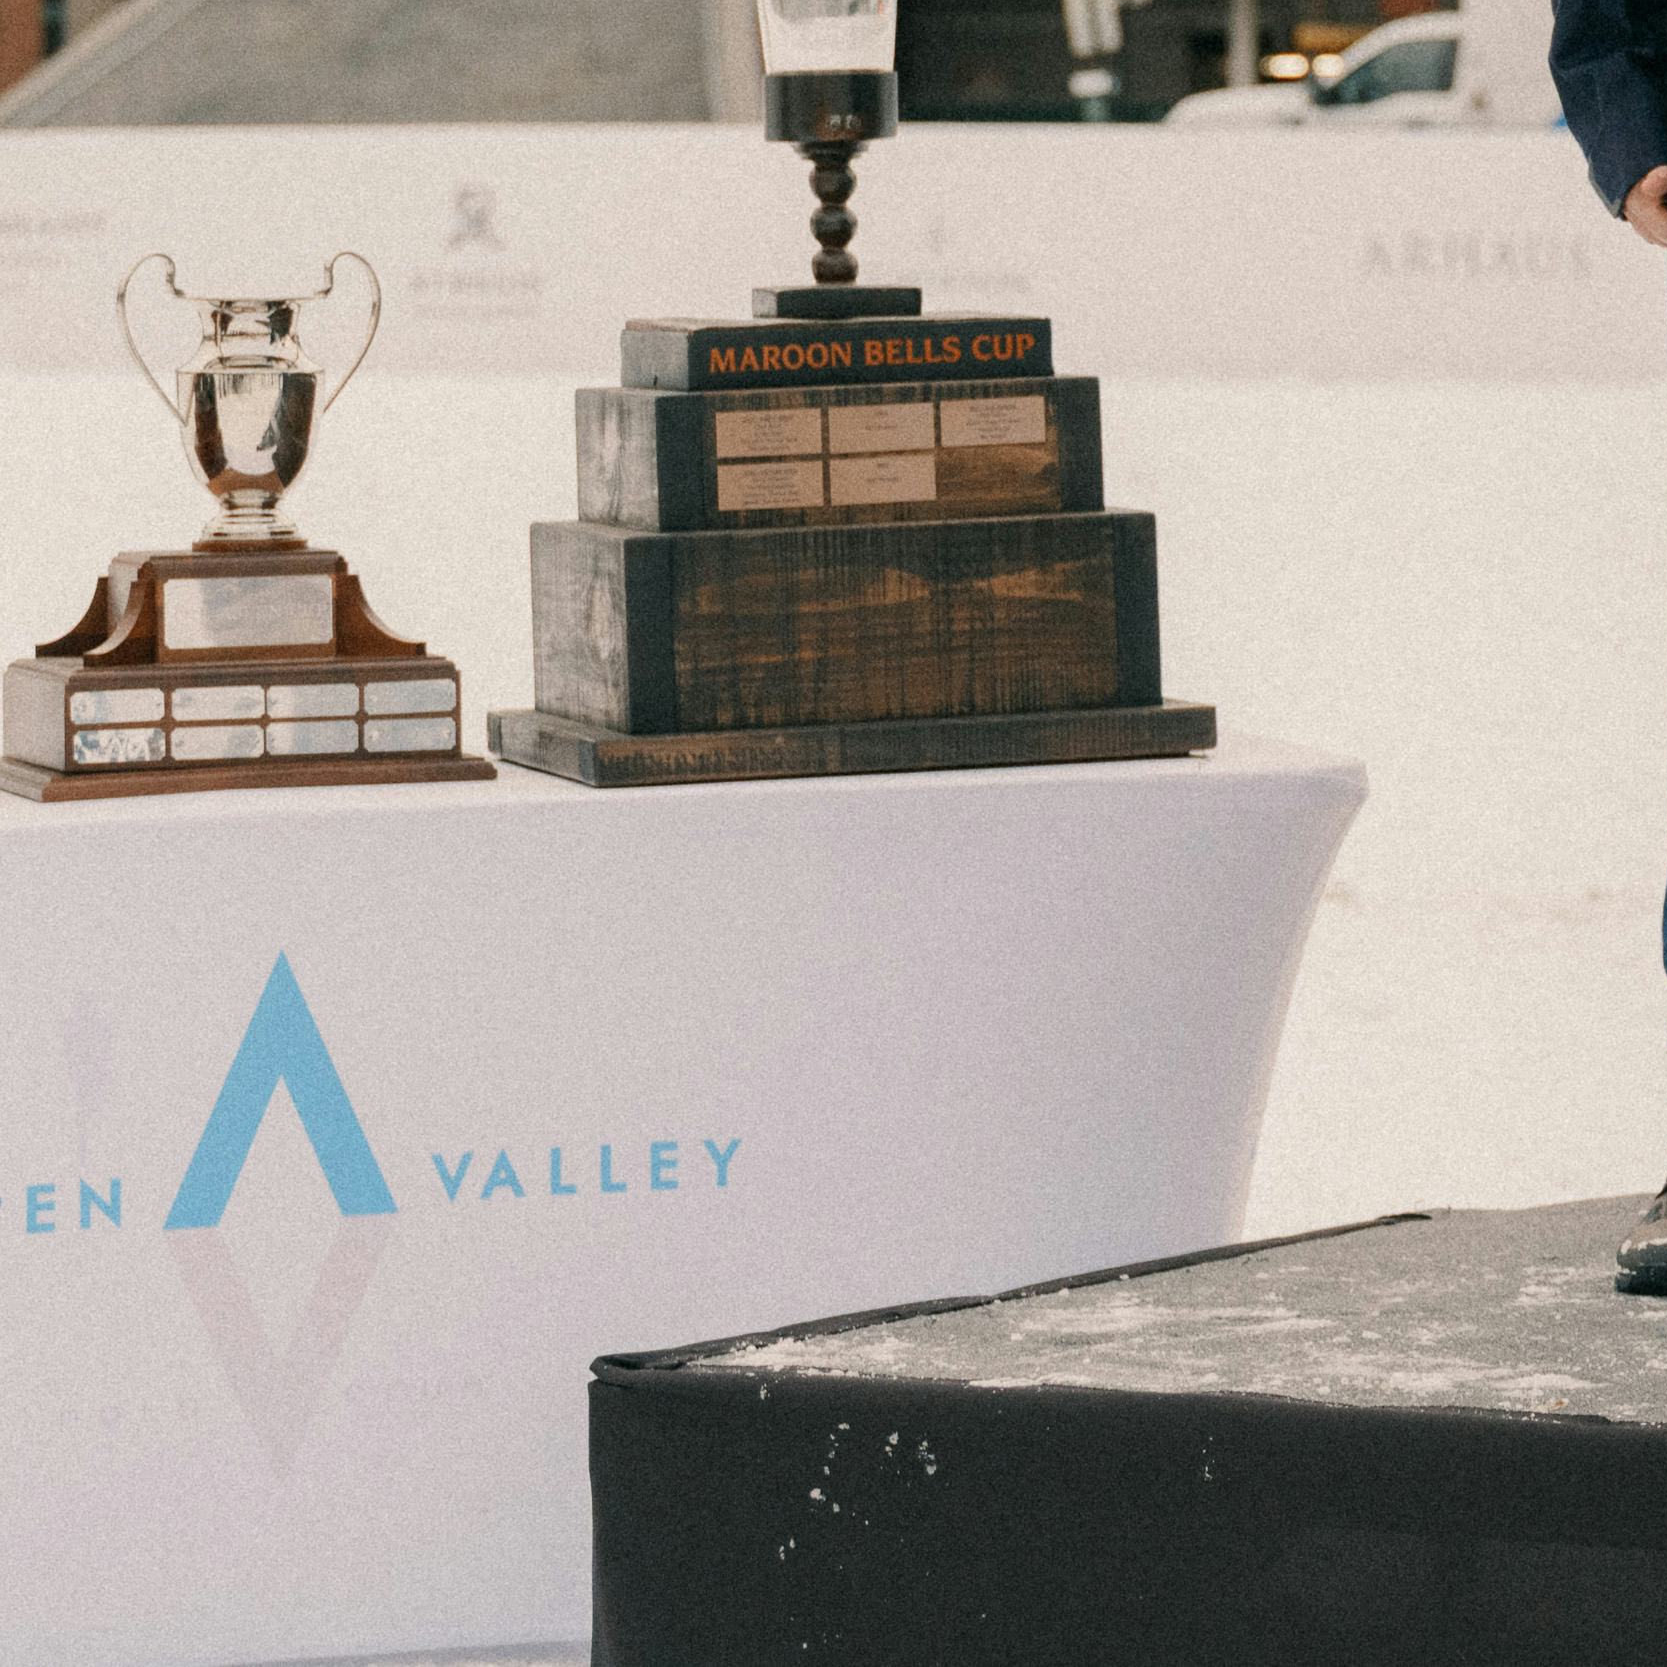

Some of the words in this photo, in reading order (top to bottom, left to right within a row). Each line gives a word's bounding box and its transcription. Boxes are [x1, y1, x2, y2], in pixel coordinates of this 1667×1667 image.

[708, 340, 852, 374] MAROON
[864, 335, 962, 366] BELLS
[970, 332, 1036, 362] CUP
[430, 1136, 744, 1205] VALLEY
